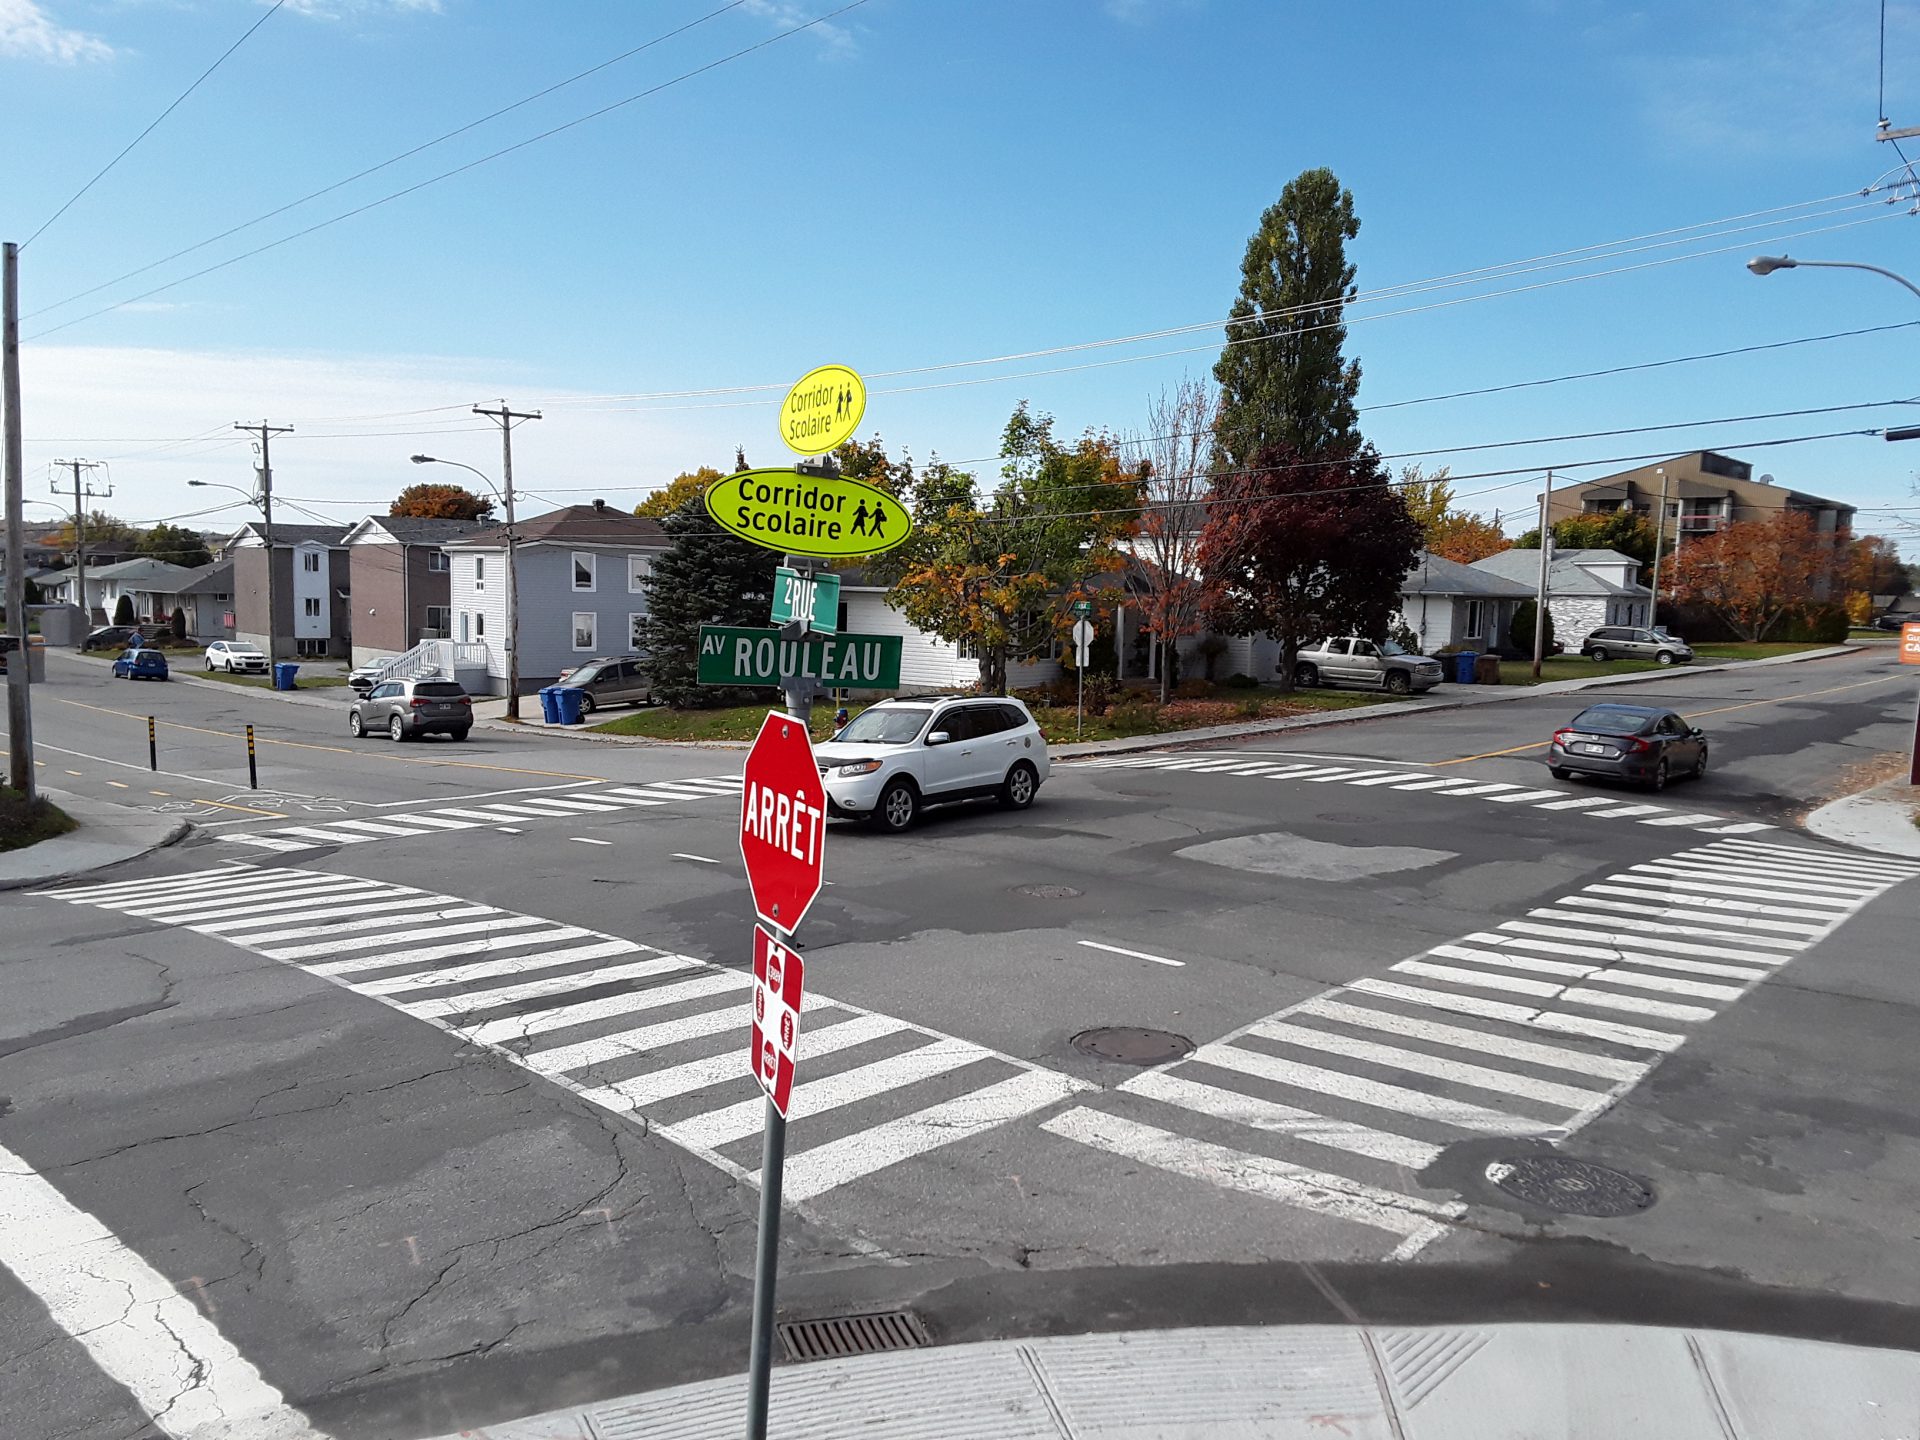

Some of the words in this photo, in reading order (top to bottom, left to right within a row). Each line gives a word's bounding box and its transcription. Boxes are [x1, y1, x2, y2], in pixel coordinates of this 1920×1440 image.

[790, 385, 834, 414] Corridor
[789, 411, 832, 441] Scolaire
[738, 478, 847, 513] Corridor
[736, 506, 842, 540] Scolaire
[701, 634, 726, 655] AV
[734, 637, 882, 681] ROULEAU
[744, 781, 821, 866] ARRÊT
